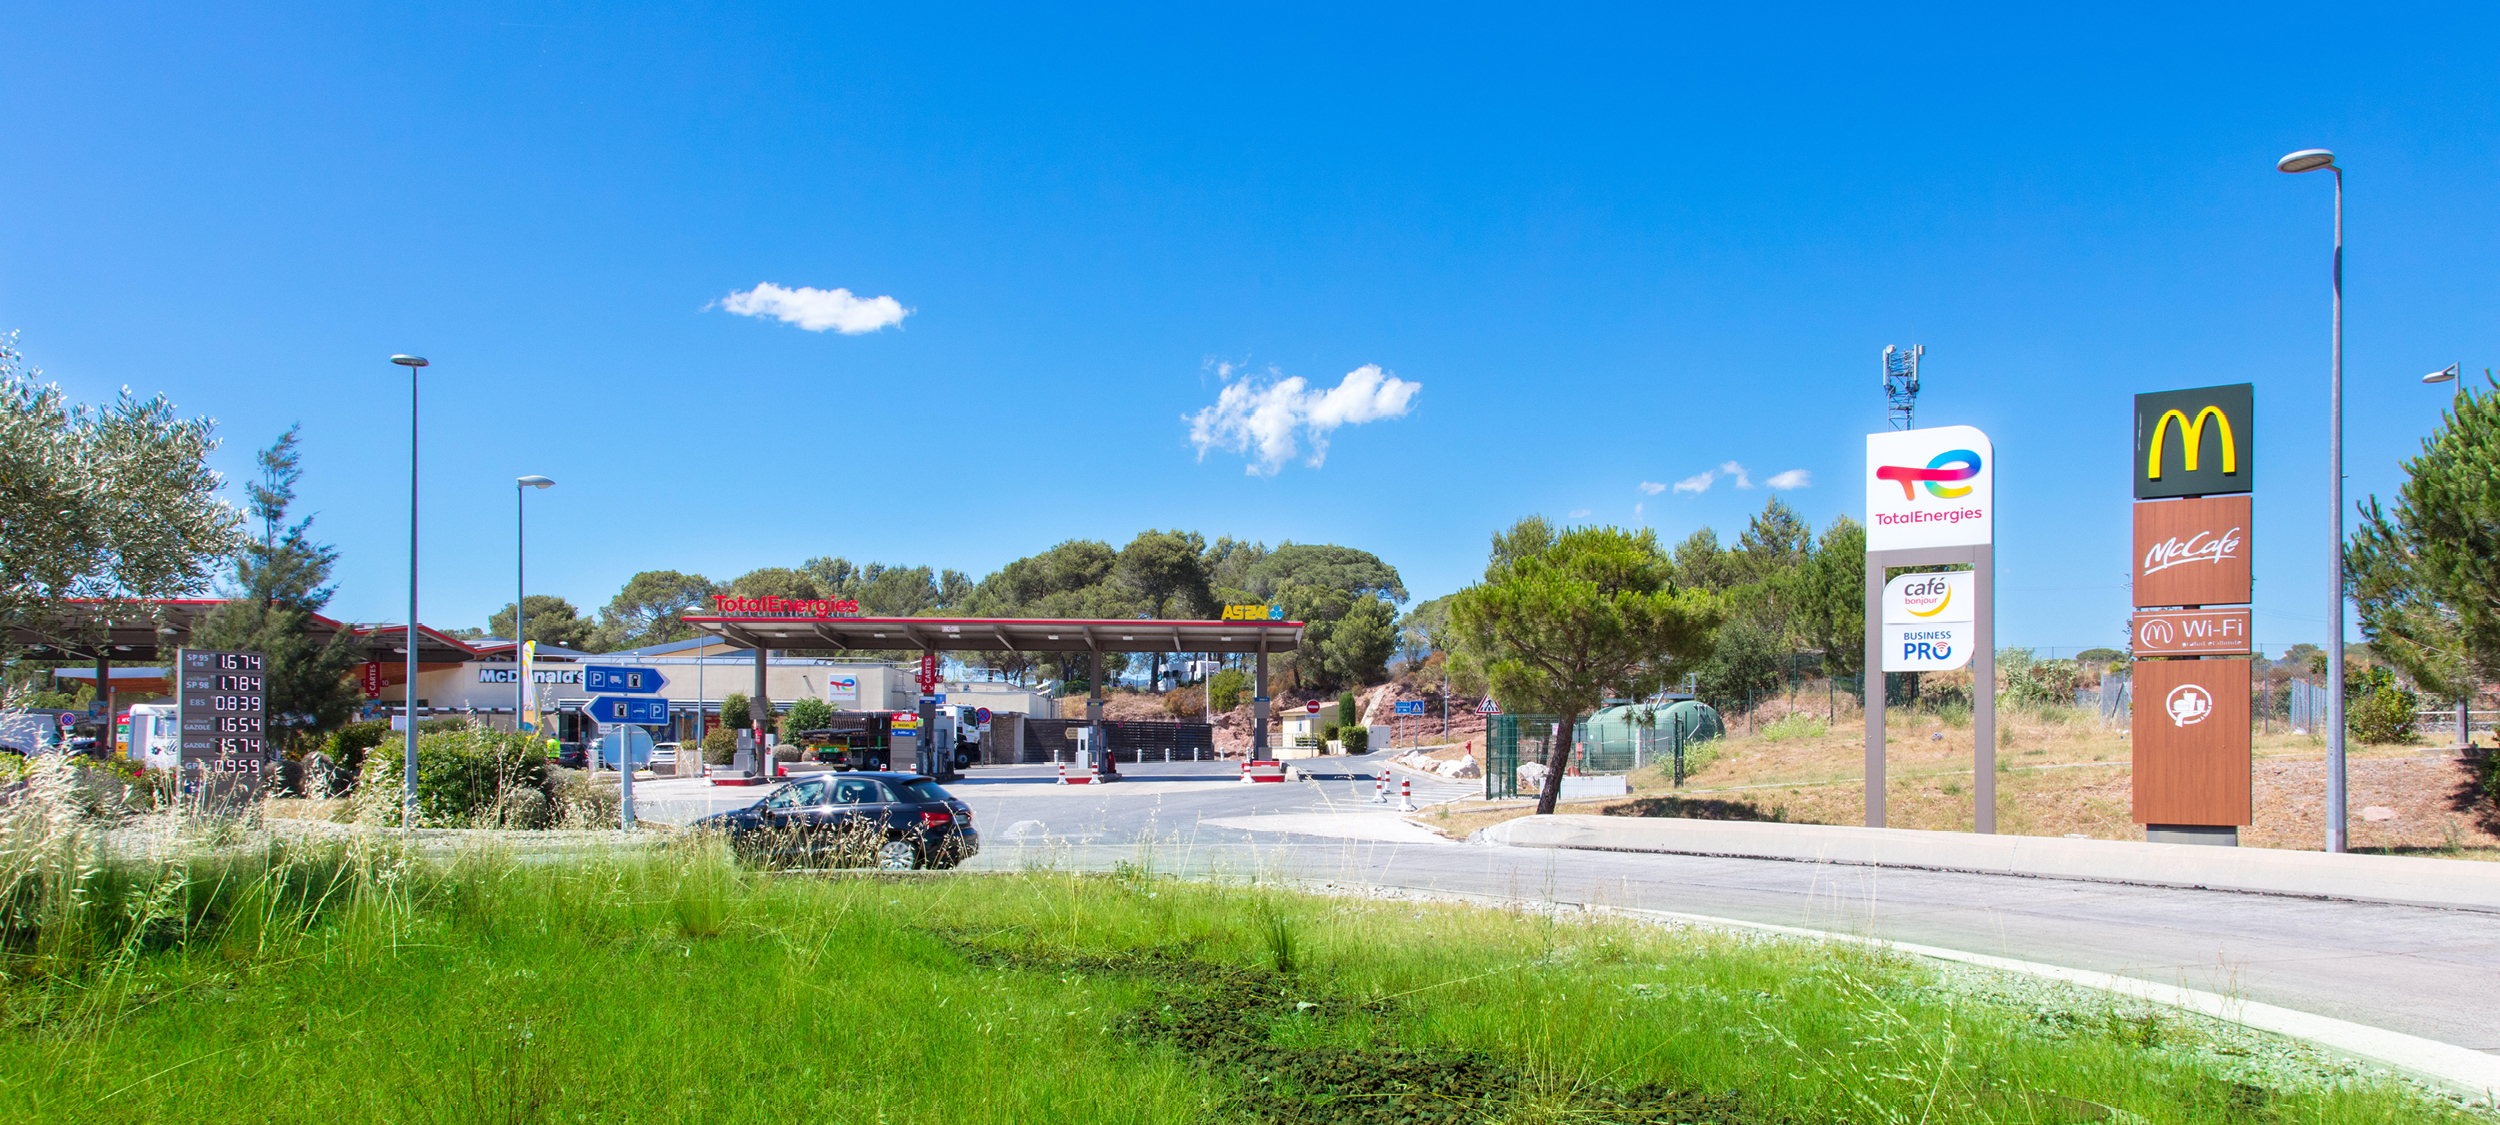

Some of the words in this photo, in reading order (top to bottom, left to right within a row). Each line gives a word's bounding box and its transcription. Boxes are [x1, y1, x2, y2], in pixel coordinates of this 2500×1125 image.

[1875, 507, 1982, 525] TotalEnergies
[2144, 527, 2240, 570] McCafé
[1904, 577, 1946, 597] café
[712, 595, 859, 617] TotalEnergies
[1905, 597, 1938, 606] bonjour
[1221, 605, 1267, 620] AS24
[1904, 630, 1952, 640] BUSINESS
[2182, 619, 2242, 637] Wi-Fi
[187, 653, 198, 661] SP
[199, 654, 209, 662] 95
[221, 654, 261, 670] 1.674
[186, 681, 198, 689] SP
[222, 676, 261, 691] 1.784
[479, 669, 584, 683] McDnald's
[215, 696, 261, 711] 0.839
[221, 717, 261, 732] 1.654
